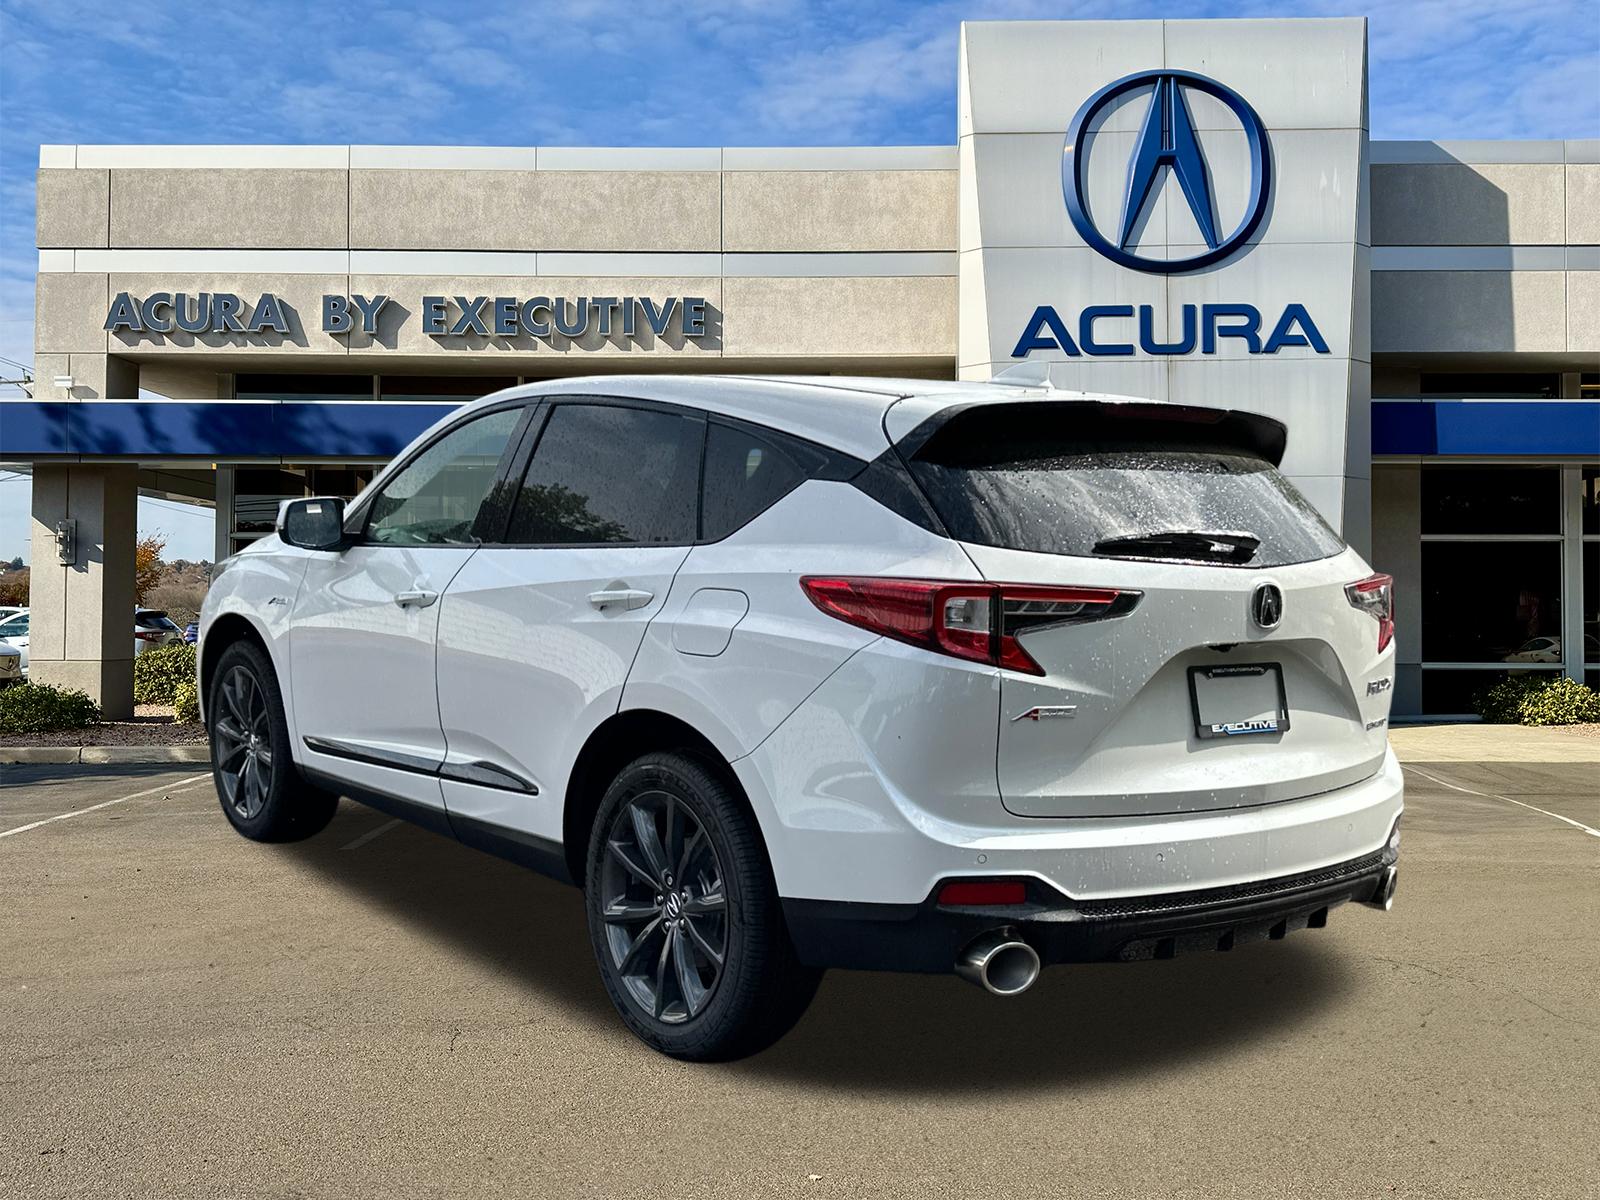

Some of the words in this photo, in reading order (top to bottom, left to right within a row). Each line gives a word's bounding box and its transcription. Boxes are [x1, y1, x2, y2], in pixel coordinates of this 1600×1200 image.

[103, 292, 290, 333] ACURA
[322, 294, 390, 334] BY
[422, 295, 706, 337] EXECUTIVE
[1010, 303, 1332, 357] ACURA
[1211, 720, 1278, 733] EXECUTIVE
